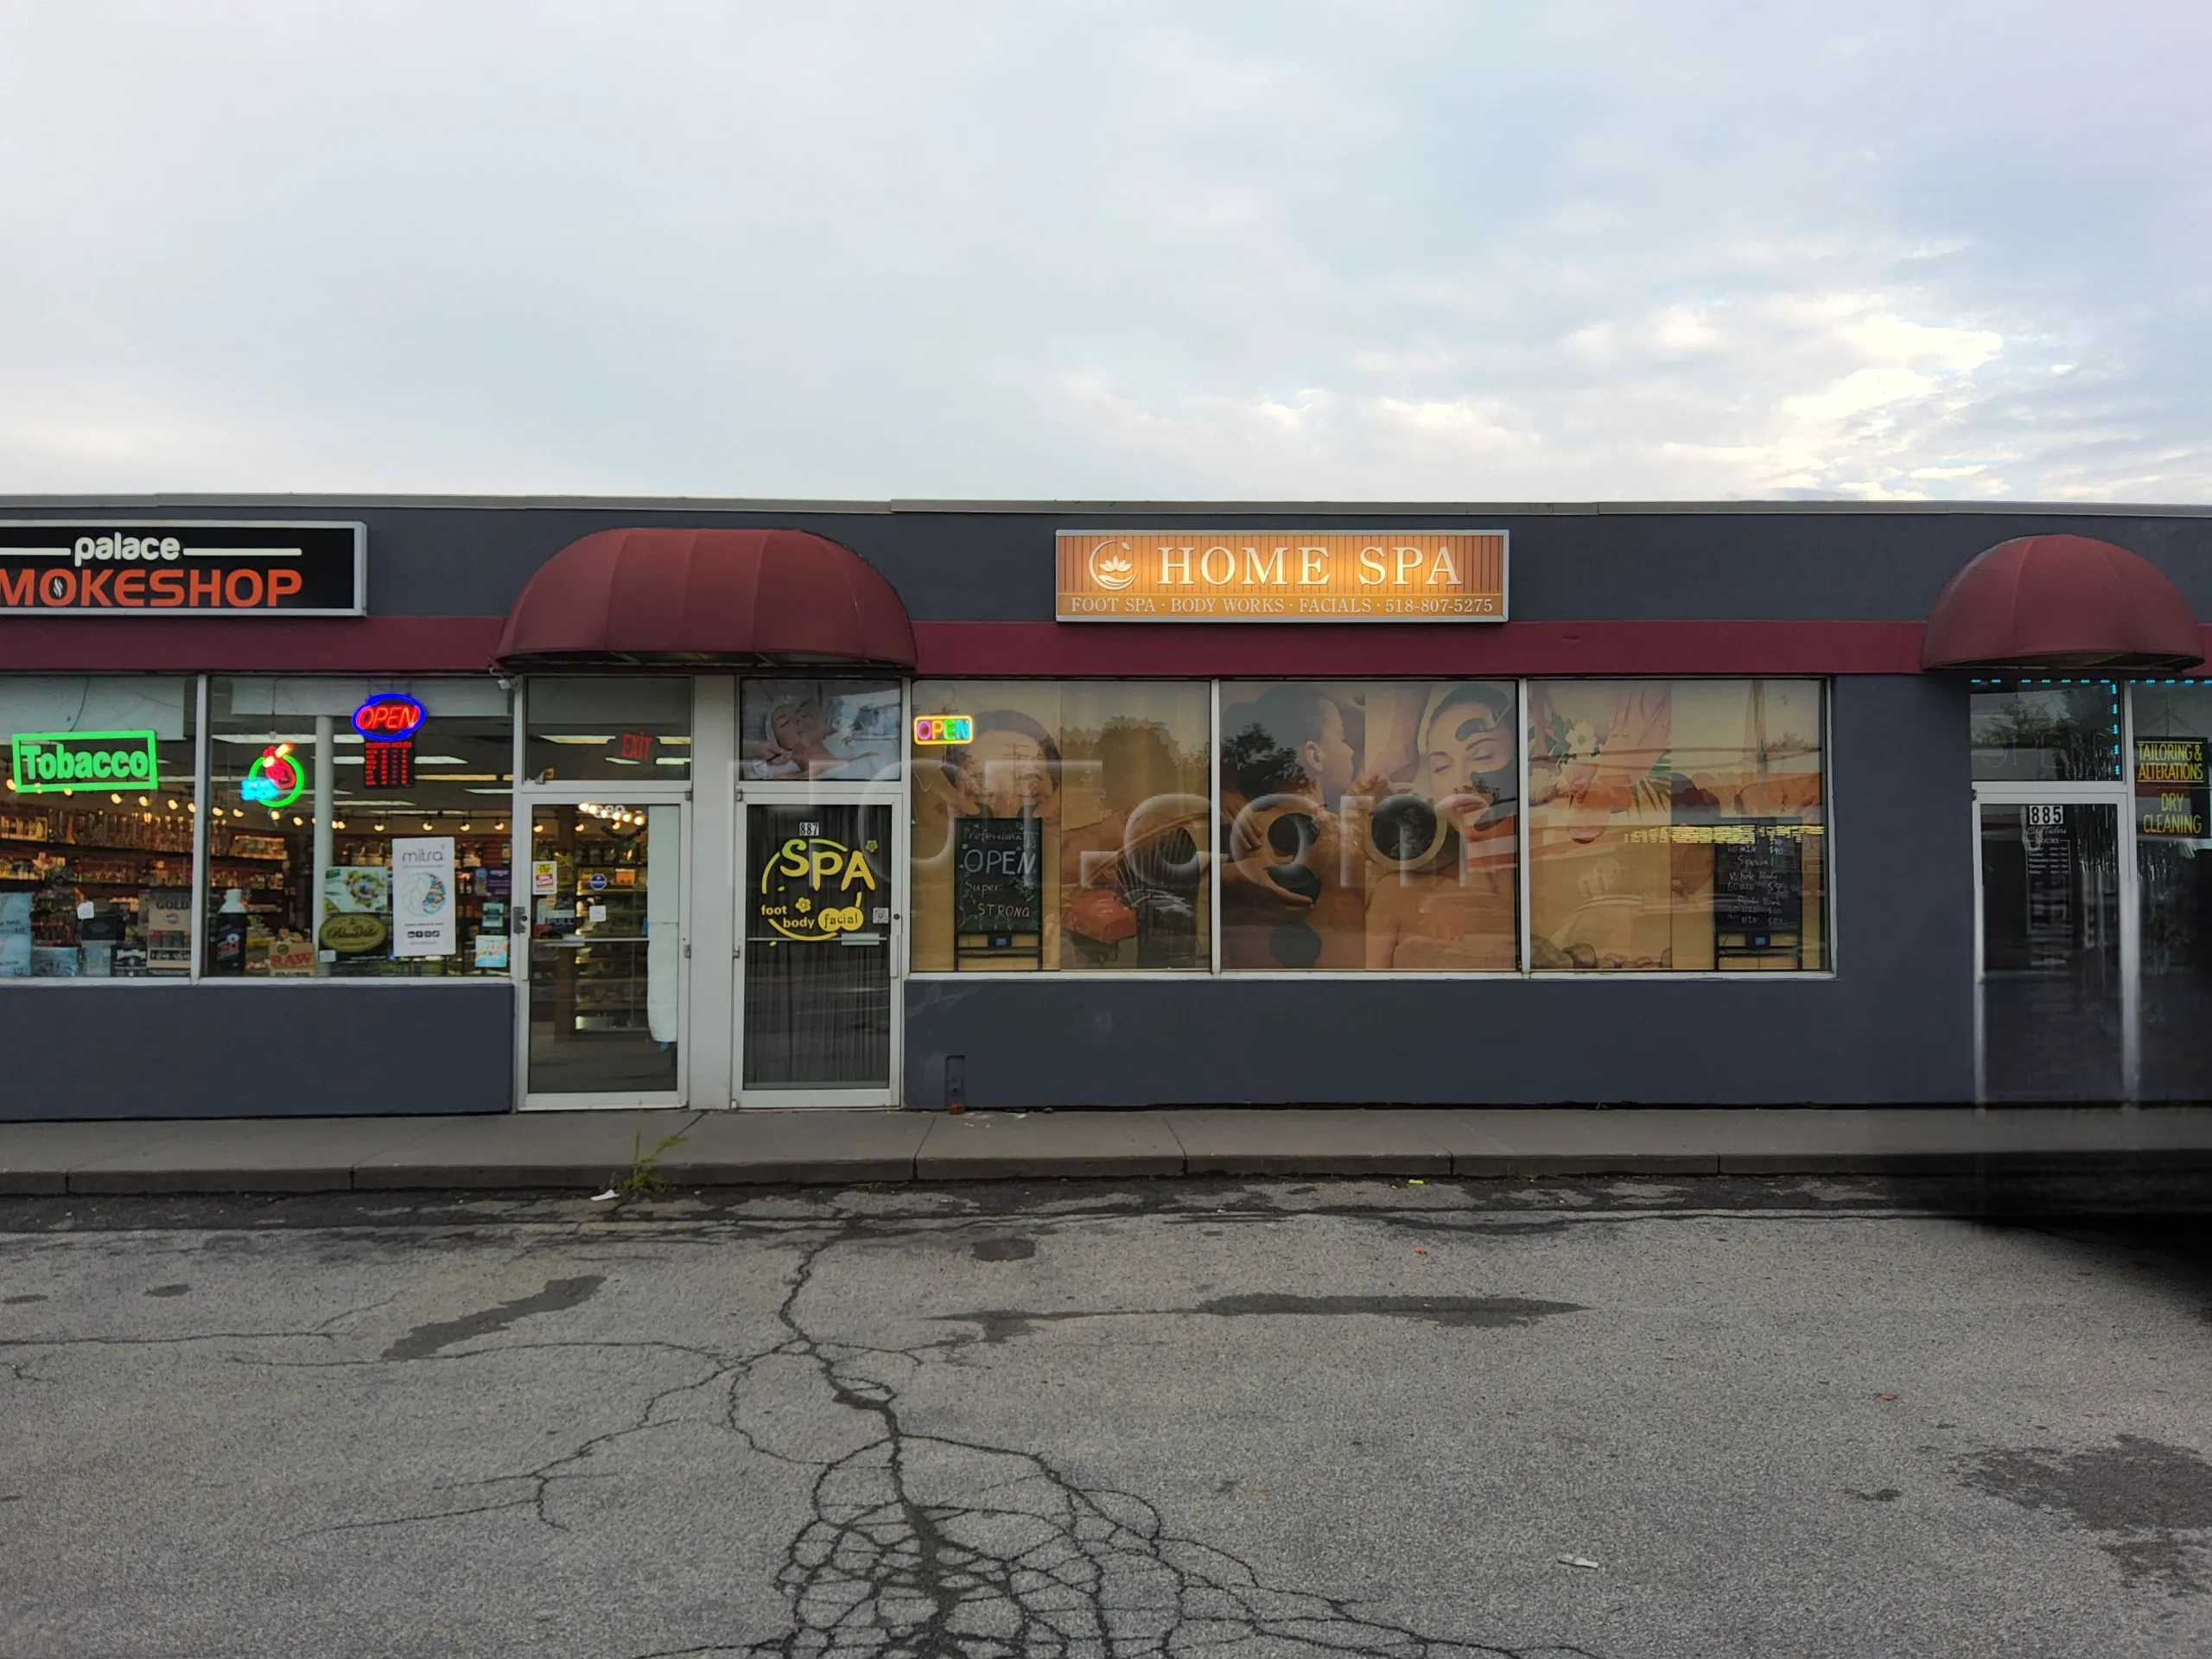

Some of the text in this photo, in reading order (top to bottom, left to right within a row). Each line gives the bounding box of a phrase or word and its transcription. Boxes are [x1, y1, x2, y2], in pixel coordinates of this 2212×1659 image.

[74, 532, 181, 567] palace
[1157, 545, 1462, 586] HOME SPA
[1071, 597, 1493, 613] FOOT SPA BODY WORKS FACIALS 518-807-5275
[356, 704, 420, 729] OPEN
[917, 719, 970, 741] OPEN
[621, 734, 653, 760] EXIT
[2138, 743, 2193, 761] TAILORING
[20, 743, 149, 779] Tobacco
[2138, 762, 2203, 780] ALTERATIONS
[2161, 792, 2184, 811] DRY
[2031, 806, 2063, 823] 885
[2142, 814, 2202, 834] CLEANING
[800, 823, 819, 836] 887
[402, 848, 443, 862] mitra
[779, 838, 875, 891] SPA
[963, 849, 1036, 874] OPEN
[964, 880, 1002, 899] Super
[760, 905, 788, 915] foot
[976, 903, 1030, 917] STRONG
[782, 912, 858, 929] body facial
[270, 953, 313, 967] RAW
